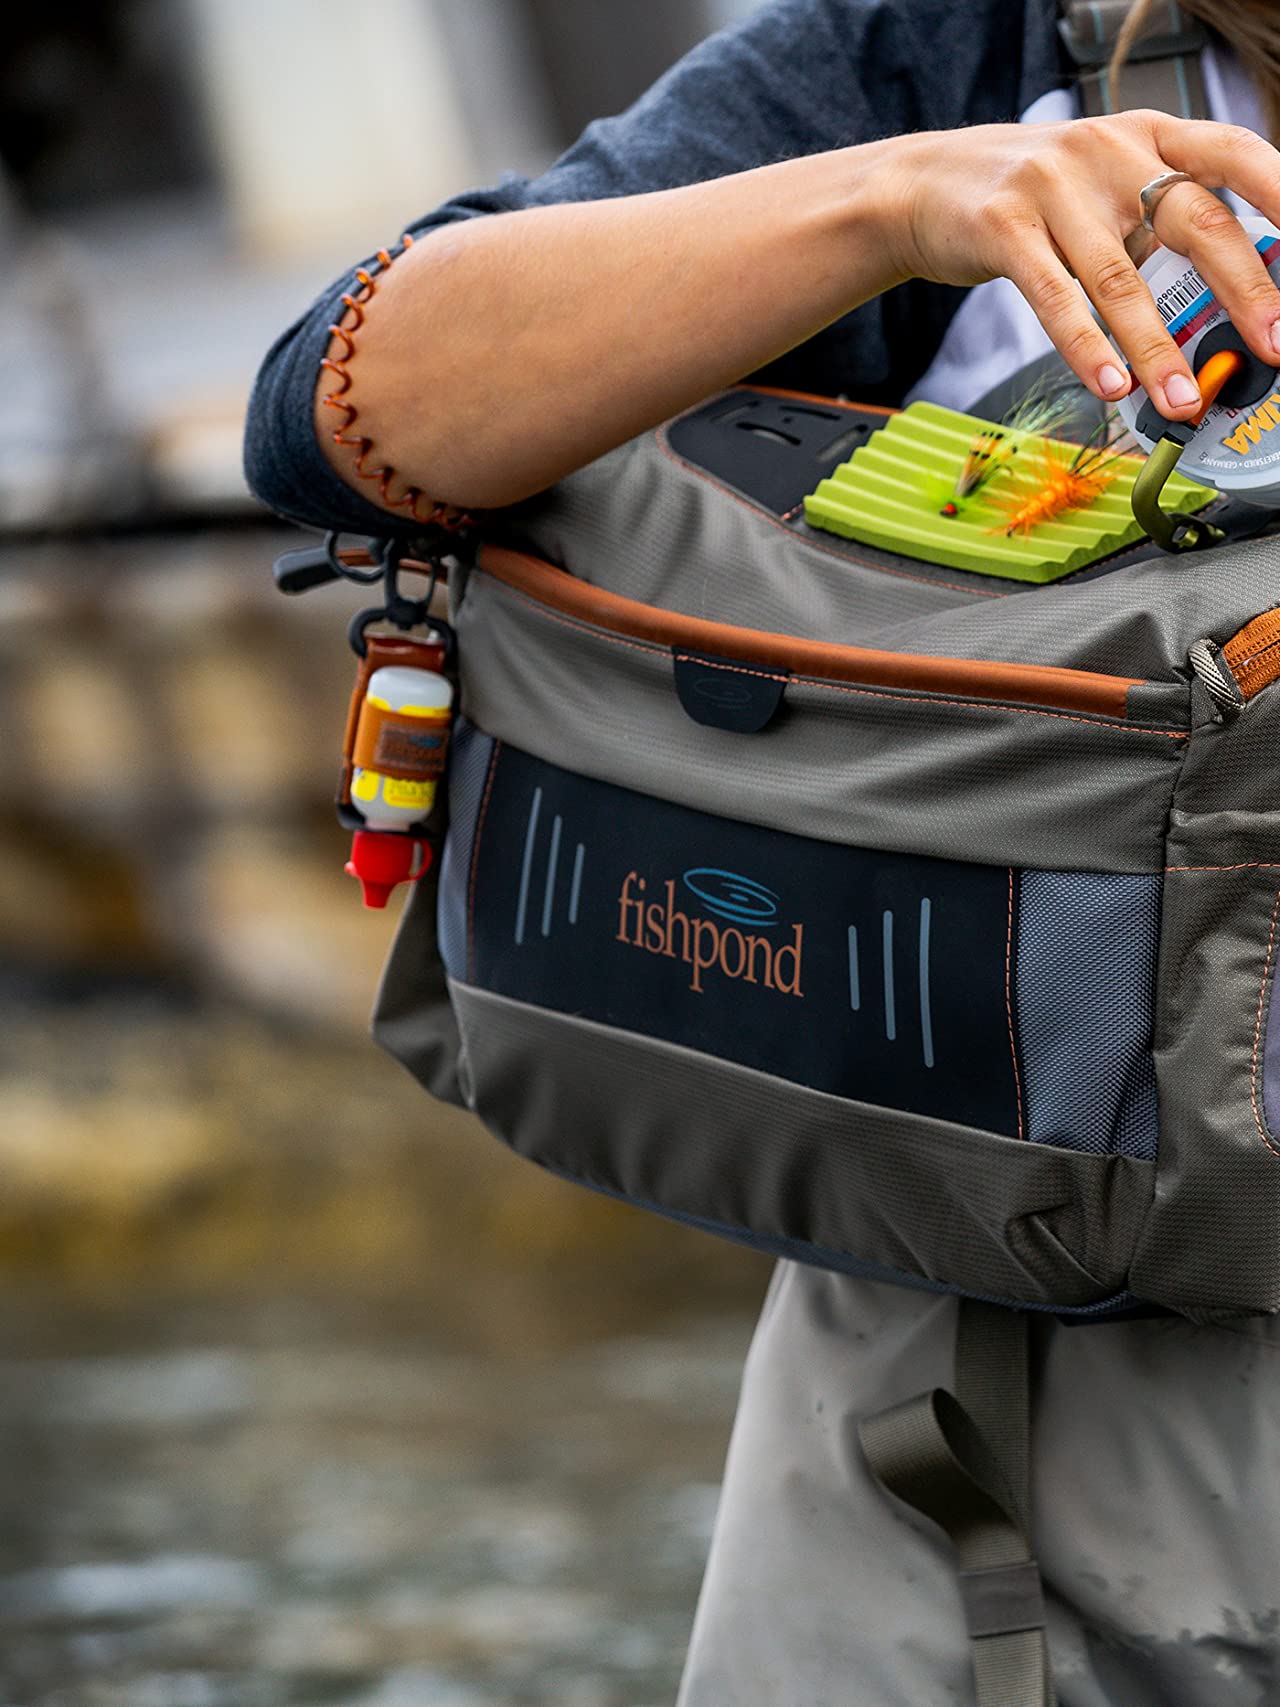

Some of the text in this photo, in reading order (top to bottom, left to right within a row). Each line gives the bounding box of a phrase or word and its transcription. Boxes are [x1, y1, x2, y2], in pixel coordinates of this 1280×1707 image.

[1156, 280, 1182, 305] 04060
[1201, 457, 1238, 470] GERMANY
[615, 870, 805, 998] fishpond
